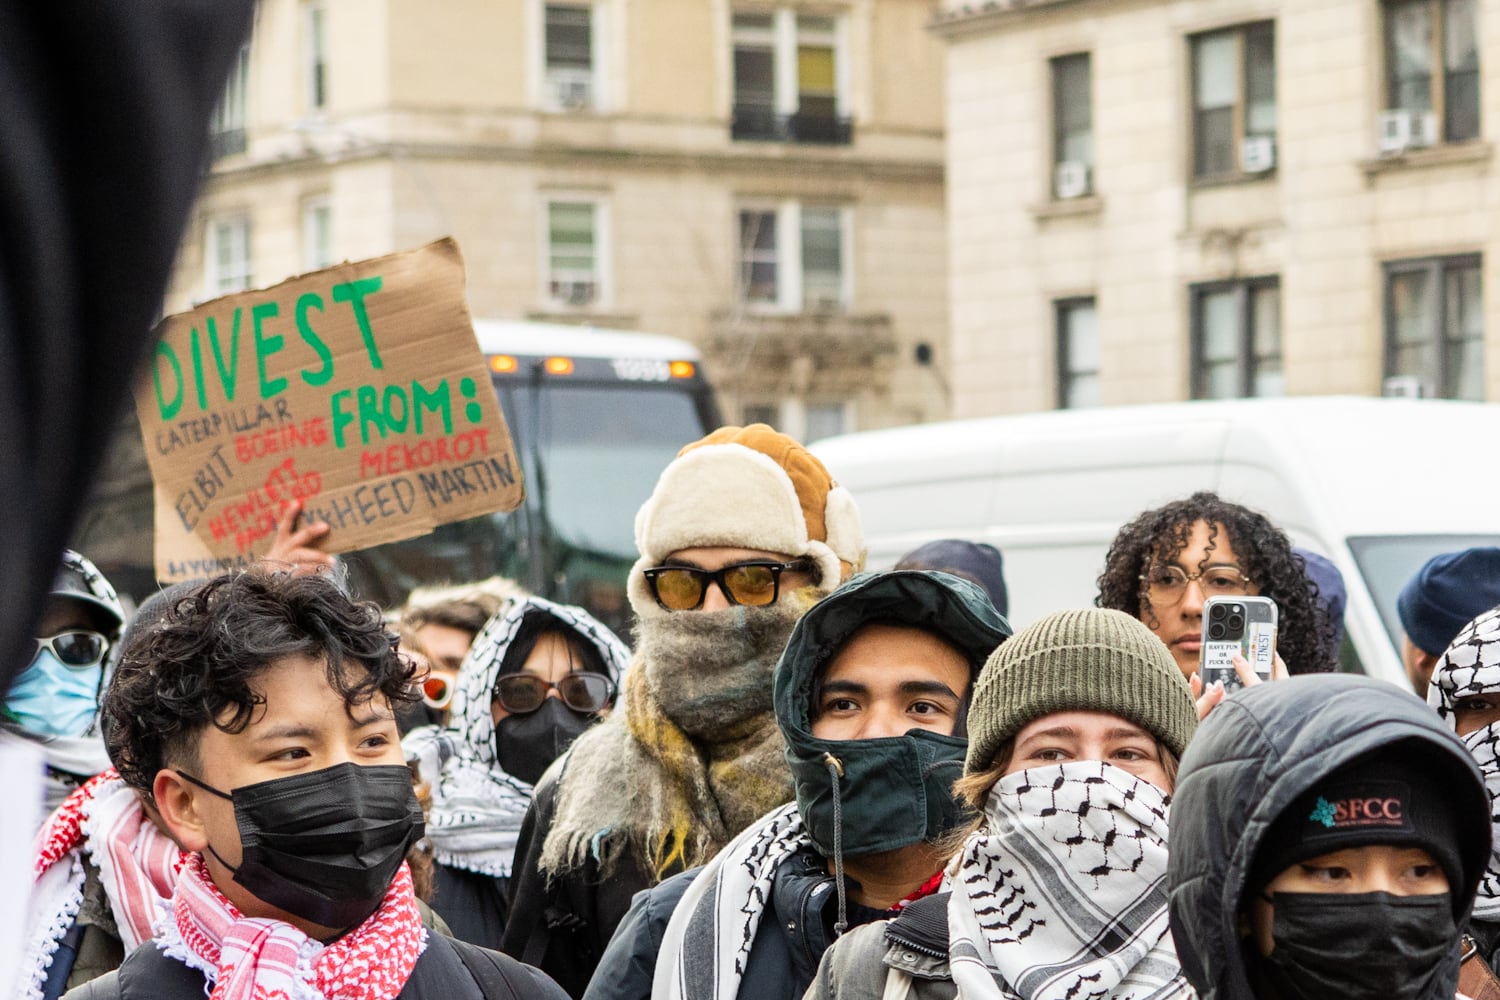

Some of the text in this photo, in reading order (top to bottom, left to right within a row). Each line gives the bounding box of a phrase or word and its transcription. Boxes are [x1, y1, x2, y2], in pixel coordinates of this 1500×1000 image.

[151, 275, 385, 422] DIVEST
[155, 399, 293, 457] CATERPILLAR
[235, 416, 328, 465] BOEING
[330, 377, 483, 449] FROM:
[360, 428, 490, 480] MEKOROT
[418, 452, 516, 508] MARTIN
[175, 444, 234, 533] ELBIT
[1257, 632, 1270, 662] FINEST
[1335, 797, 1402, 820] SFCC
